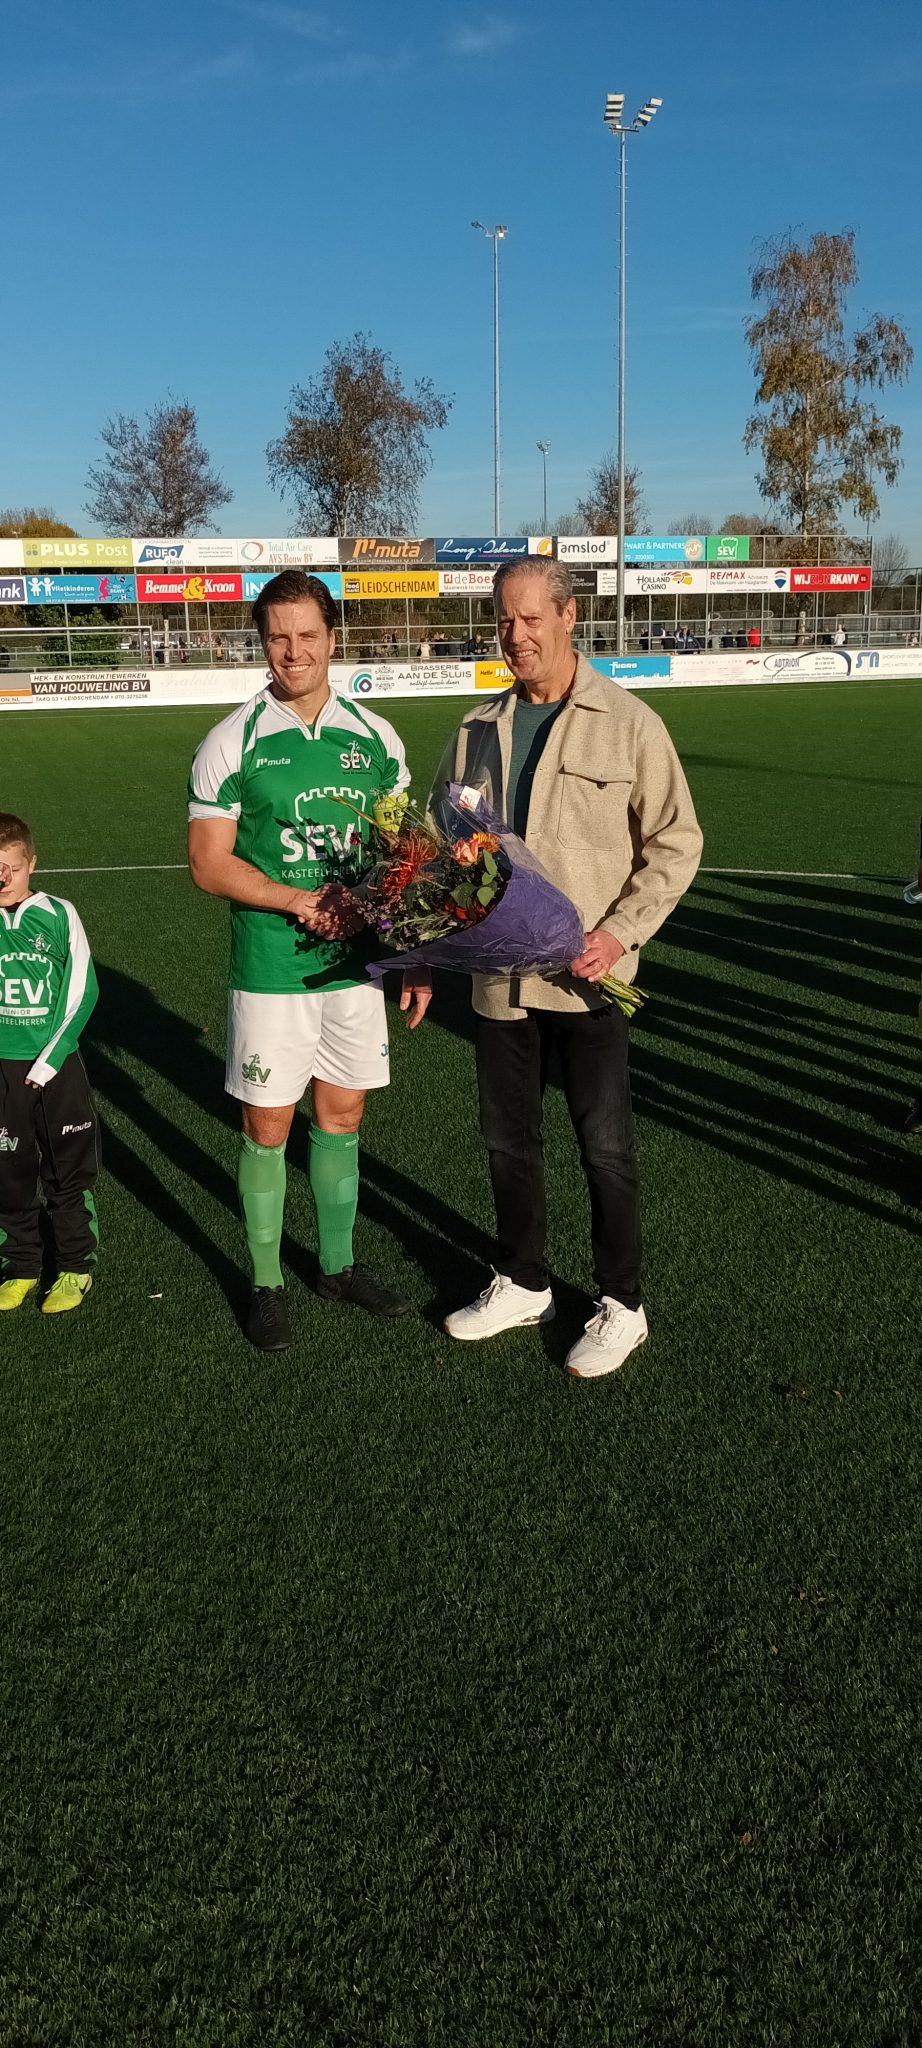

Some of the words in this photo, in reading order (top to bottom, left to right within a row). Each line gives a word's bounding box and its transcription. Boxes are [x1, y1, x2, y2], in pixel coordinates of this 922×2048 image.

[40, 543, 89, 557] PLUS
[96, 543, 129, 557] Post
[374, 541, 421, 558] muta
[437, 538, 478, 561] Long
[483, 539, 527, 554] Island
[560, 540, 606, 554] amslod
[646, 541, 652, 550] &
[652, 541, 686, 551] PARTNERS
[716, 546, 736, 556] SEV
[145, 548, 178, 559] RUFO
[284, 553, 303, 564] Bouw
[636, 575, 671, 585] HOLLAND
[710, 571, 746, 580] RE/MAX
[0, 583, 21, 599] nk
[145, 579, 188, 594] Bemmel
[182, 576, 207, 600] &
[204, 578, 236, 593] Kroon
[362, 580, 436, 594] LEIDSCHENDAM
[641, 583, 667, 592] CASINO
[398, 672, 421, 680] AAN
[441, 670, 472, 678] SLUIS
[33, 683, 57, 693] VAN
[60, 681, 129, 693] HOUWELING
[132, 681, 148, 691] BV
[267, 757, 291, 767] muta
[340, 753, 372, 769] SEV
[279, 822, 356, 863] SEV
[0, 978, 45, 1005] EV
[241, 1061, 272, 1084] SEV
[72, 1121, 92, 1133] muta
